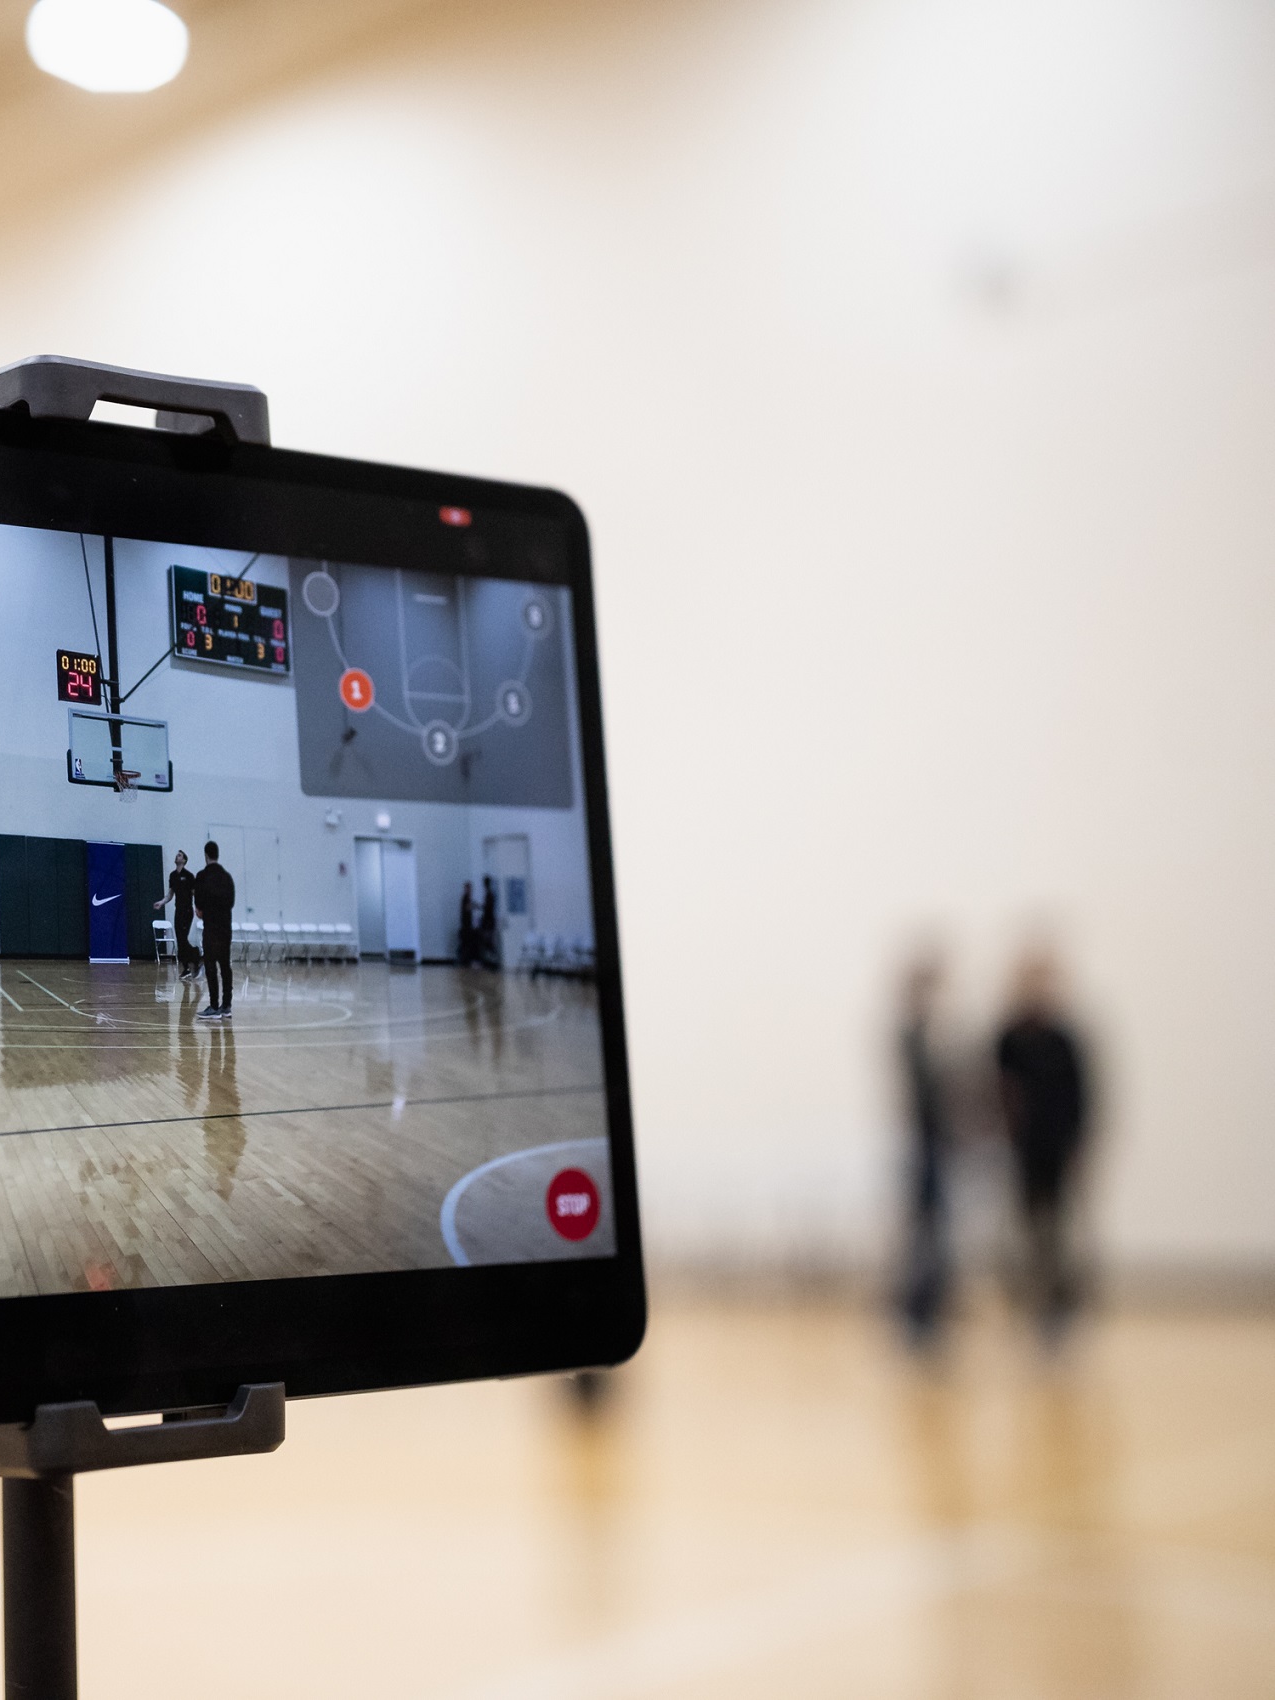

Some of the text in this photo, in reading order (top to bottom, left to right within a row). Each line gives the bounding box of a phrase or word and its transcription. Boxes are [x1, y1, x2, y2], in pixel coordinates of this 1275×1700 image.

[67, 671, 93, 697] 24
[351, 679, 362, 700] 1
[556, 1192, 591, 1217] STOP
